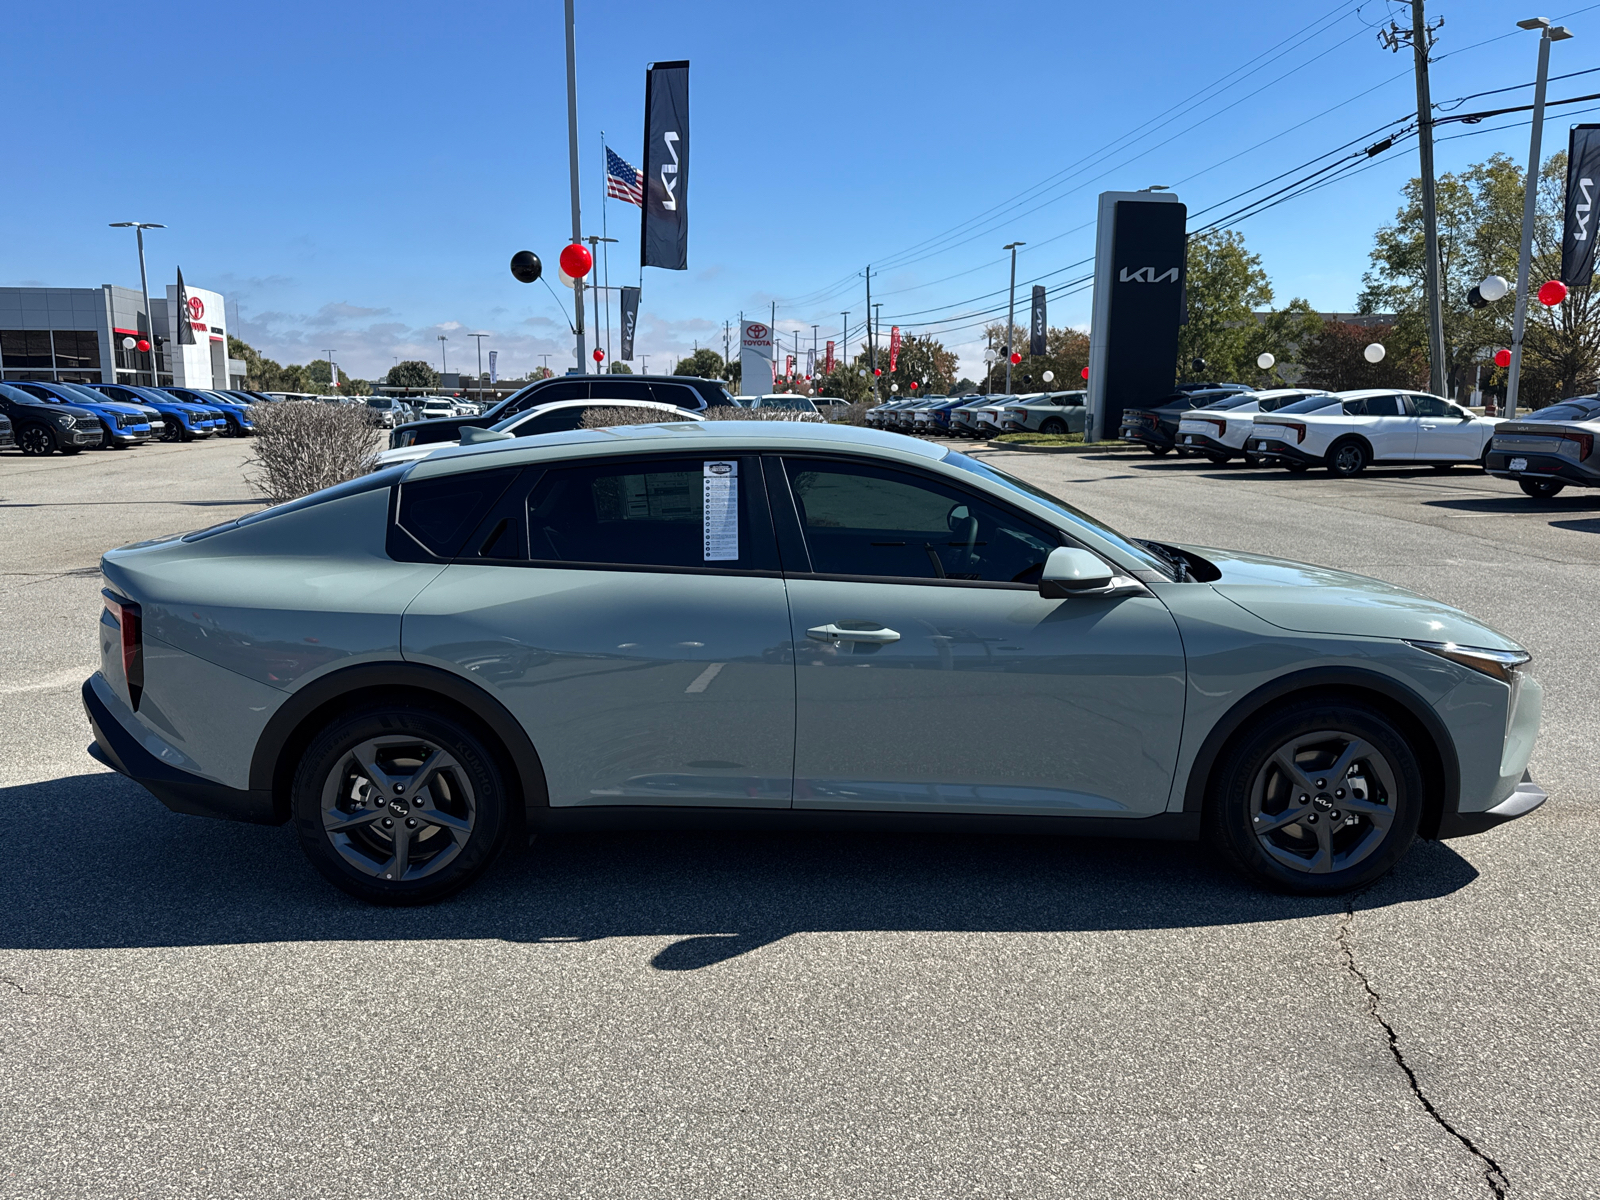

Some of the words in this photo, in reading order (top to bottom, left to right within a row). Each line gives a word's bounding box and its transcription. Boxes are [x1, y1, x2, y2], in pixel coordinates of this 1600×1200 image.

[661, 131, 680, 211] KIA
[1573, 177, 1594, 241] KIA
[1119, 266, 1179, 284] KIA
[455, 740, 492, 796] KUMHO
